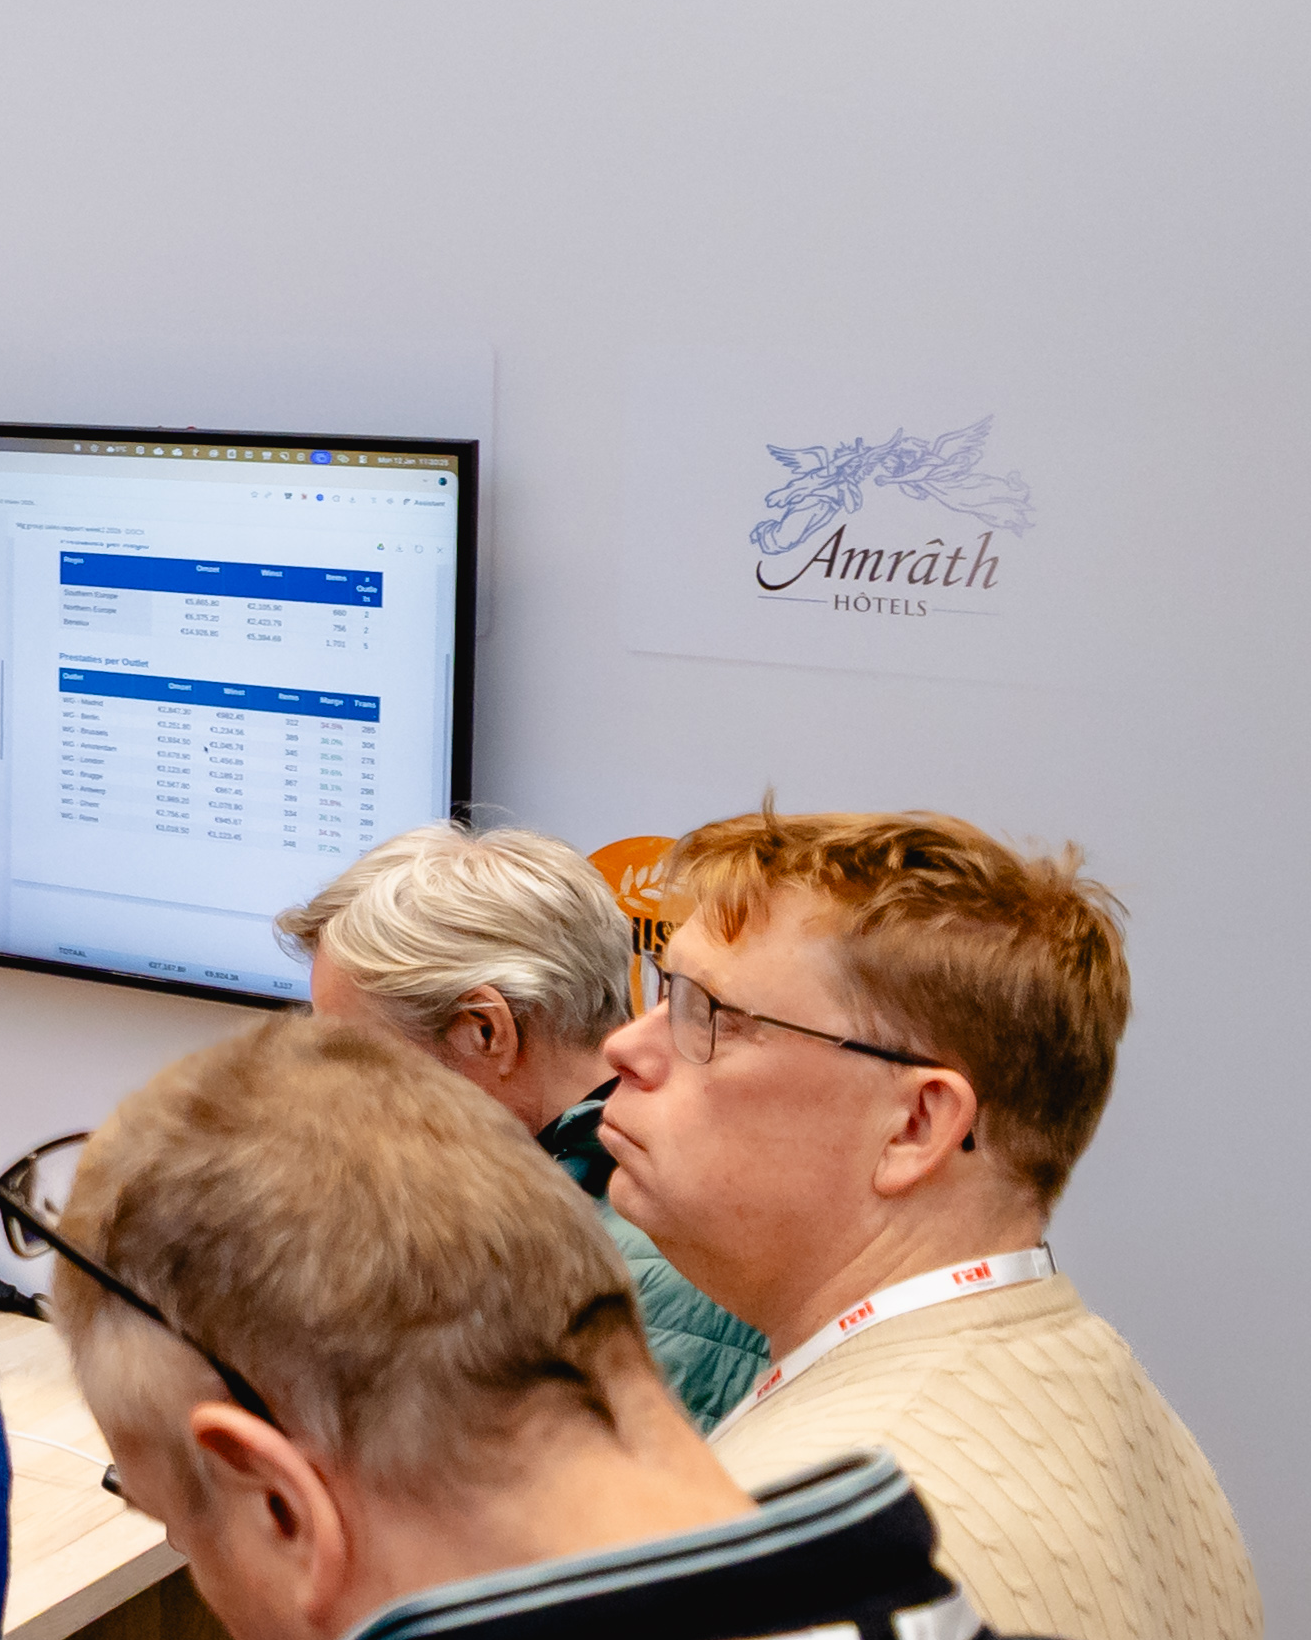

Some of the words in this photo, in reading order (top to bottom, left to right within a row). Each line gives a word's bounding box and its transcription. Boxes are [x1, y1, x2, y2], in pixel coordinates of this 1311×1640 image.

[755, 523, 1001, 592] Amrâth
[832, 591, 929, 618] HÔTELS
[59, 652, 101, 664] Prestaties
[104, 657, 118, 667] per
[121, 658, 149, 668] Outlet
[952, 1261, 993, 1285] rai
[838, 1301, 875, 1331] rai
